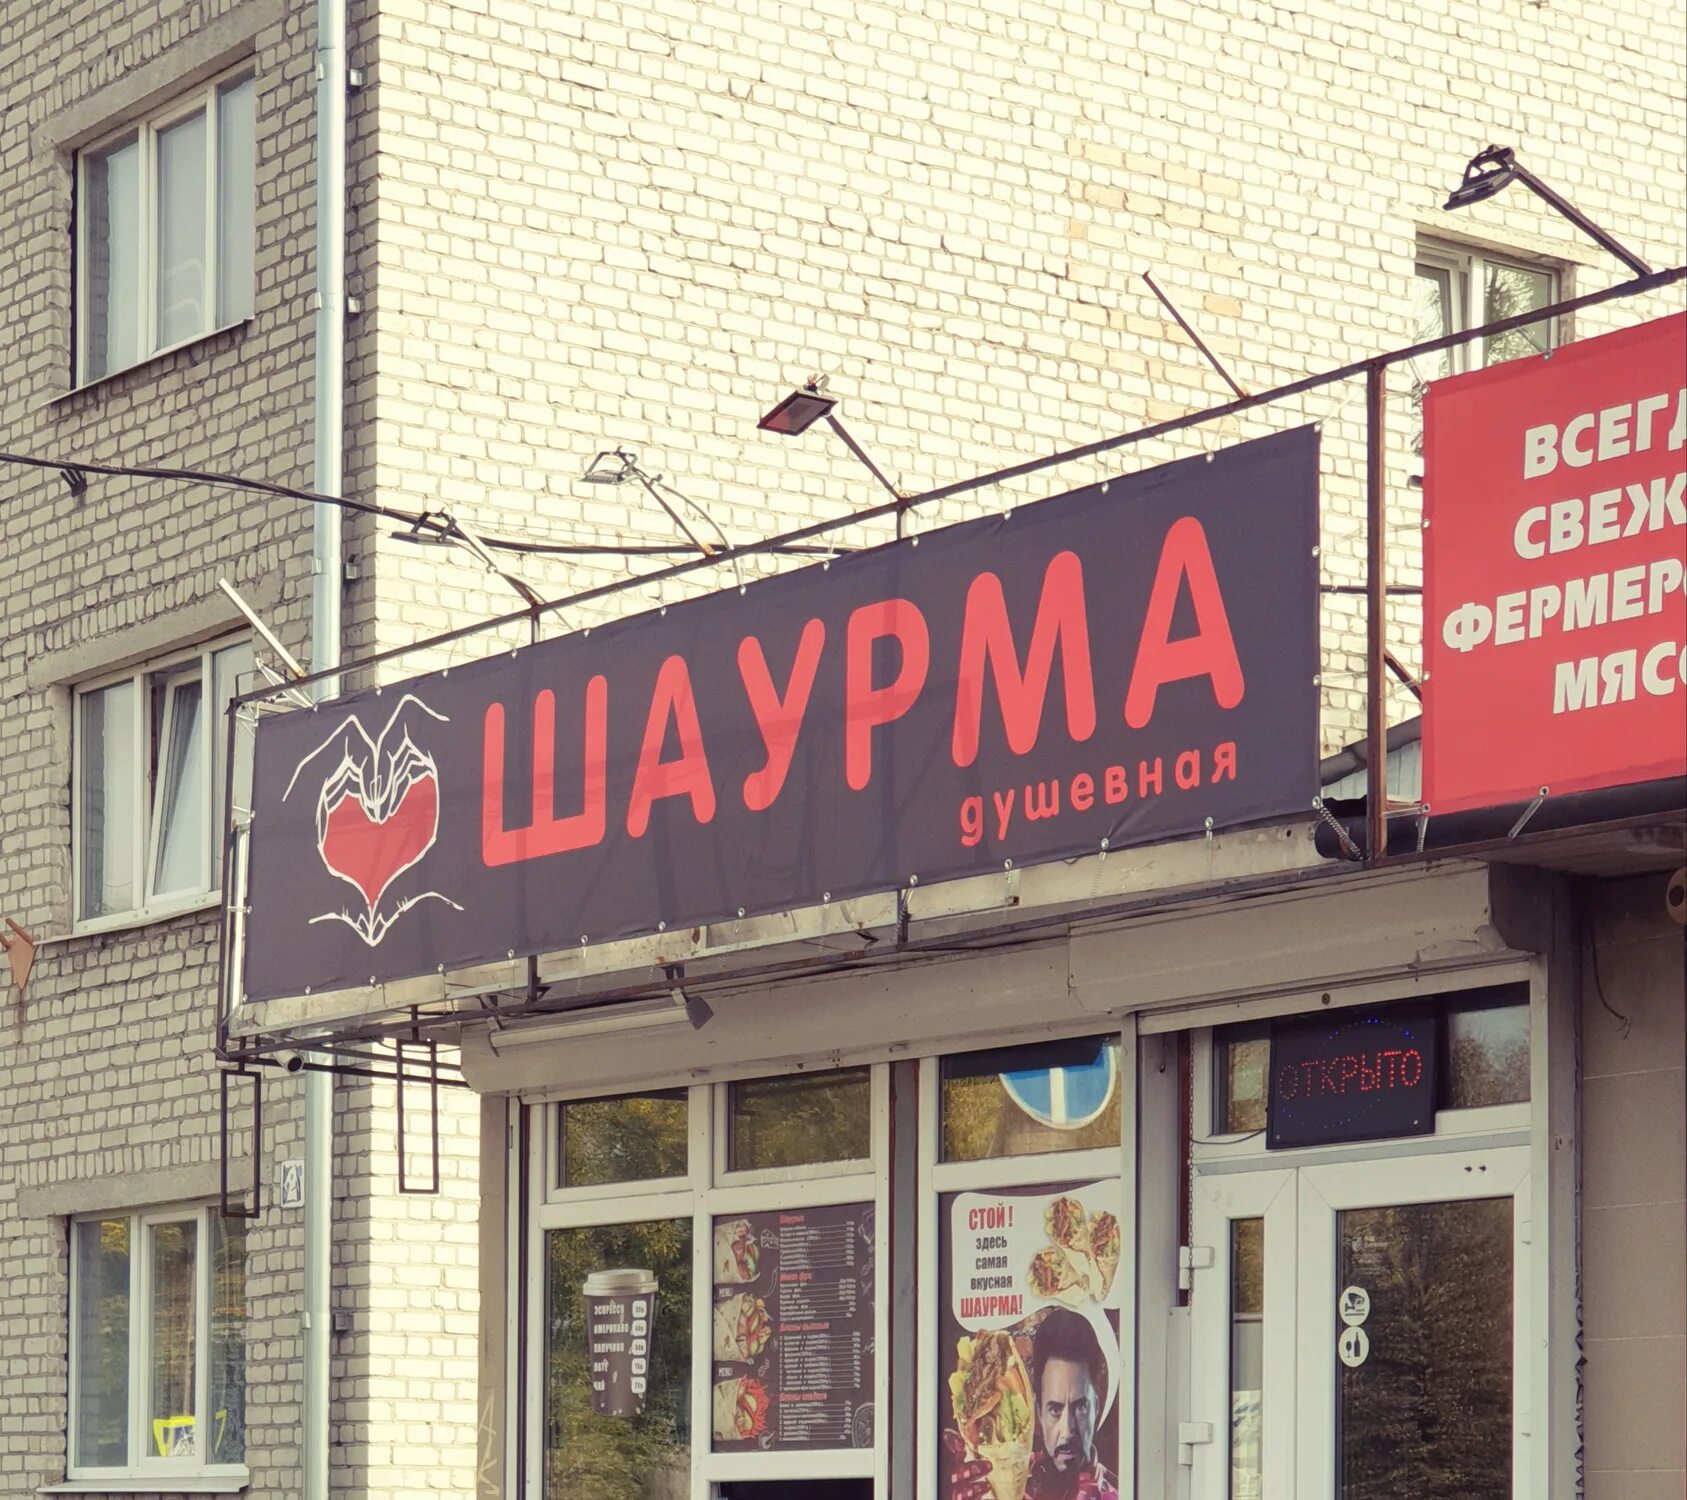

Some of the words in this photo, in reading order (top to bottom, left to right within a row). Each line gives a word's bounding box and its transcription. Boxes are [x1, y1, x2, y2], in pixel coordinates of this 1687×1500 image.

[1442, 558, 1687, 654] ФЕРМЕР
[482, 515, 1246, 868] ШАУРМА
[1553, 641, 1687, 715] МЯС
[958, 740, 1240, 847] душевная
[1278, 1048, 1423, 1101] ОТКРЫТО
[975, 1236, 1008, 1252] здесь
[975, 1255, 1008, 1270] самая
[960, 1294, 1024, 1319] ШАУРМА!
[970, 1275, 1013, 1292] вкусная
